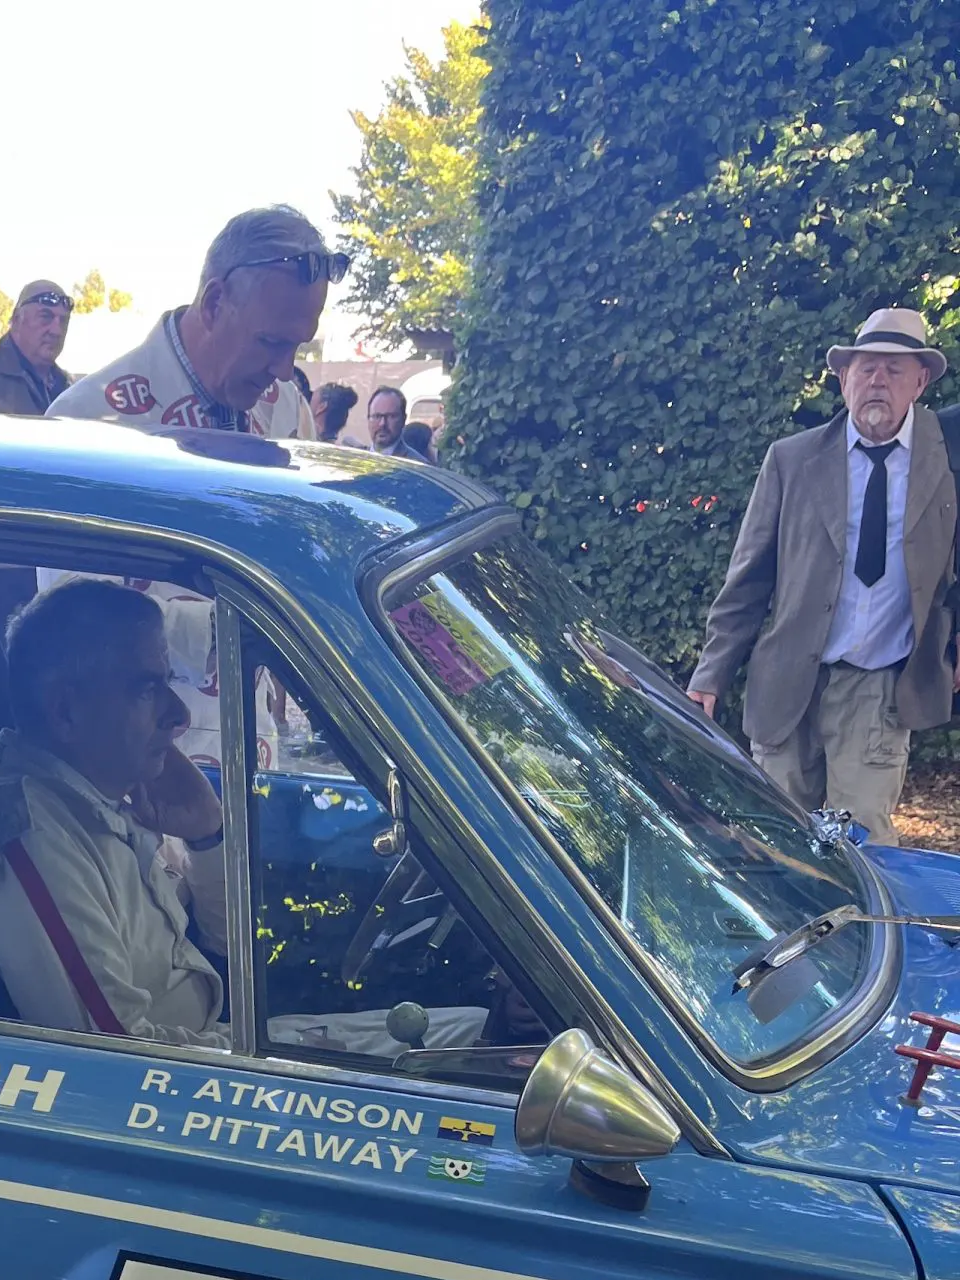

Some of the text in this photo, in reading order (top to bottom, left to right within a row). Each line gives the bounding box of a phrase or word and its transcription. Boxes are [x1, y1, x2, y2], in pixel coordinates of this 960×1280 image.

[111, 377, 149, 409] STP
[141, 1068, 424, 1136] R. ATKINSON
[126, 1102, 418, 1174] D. PITTAWAY
